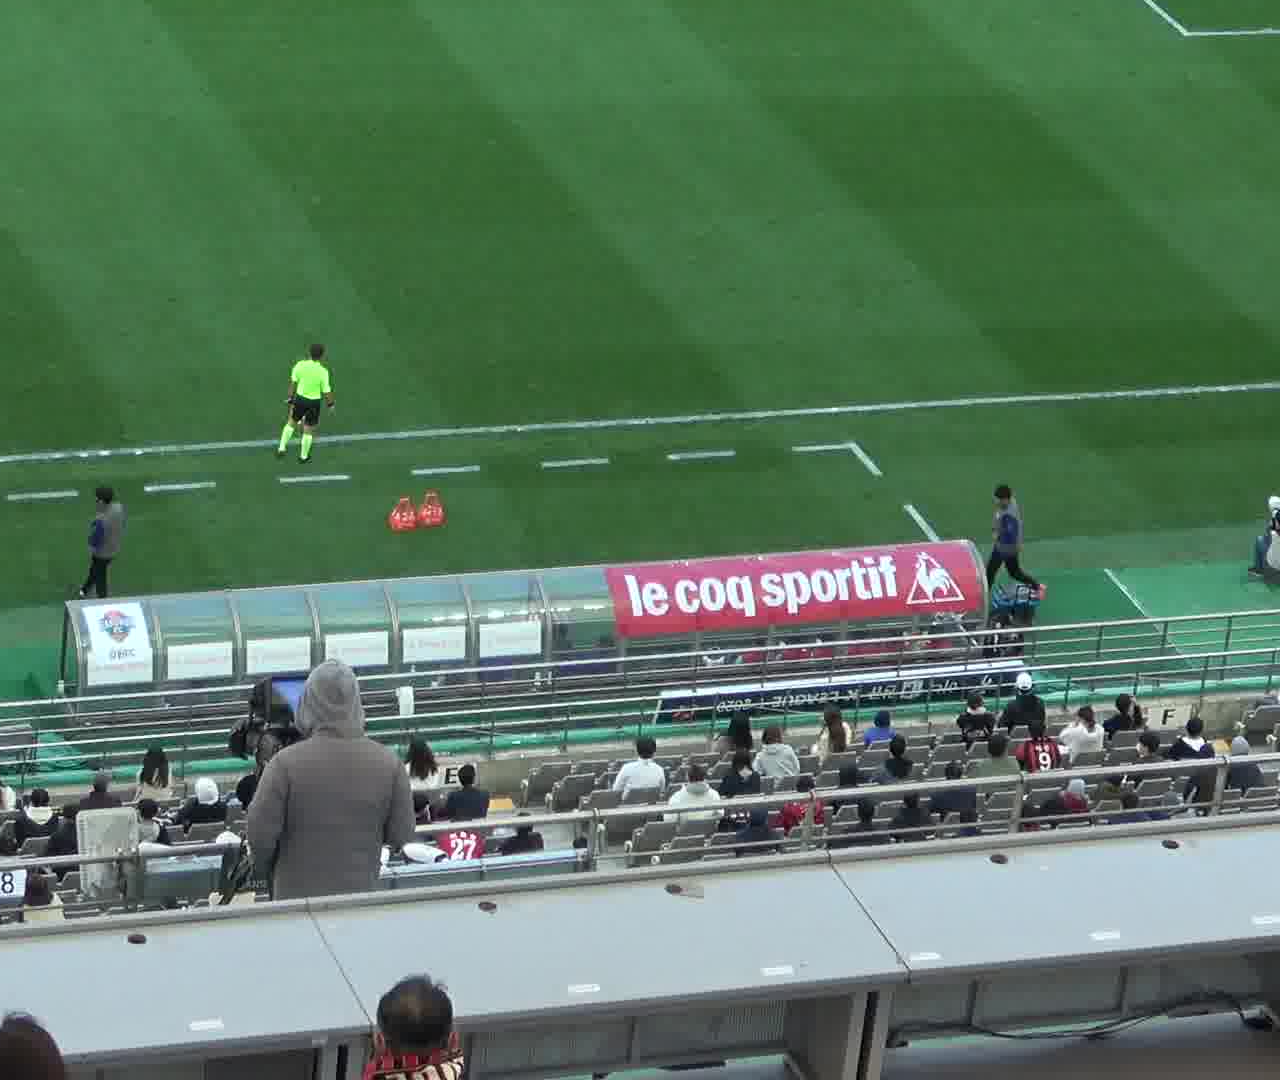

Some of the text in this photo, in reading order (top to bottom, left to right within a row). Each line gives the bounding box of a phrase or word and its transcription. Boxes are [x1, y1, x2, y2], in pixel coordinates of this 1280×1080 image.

[623, 554, 899, 617] le coq sportif
[1161, 708, 1177, 725] F
[1038, 752, 1052, 770] 9
[444, 767, 458, 784] E
[450, 838, 477, 860] 27
[1, 873, 15, 894] 8
